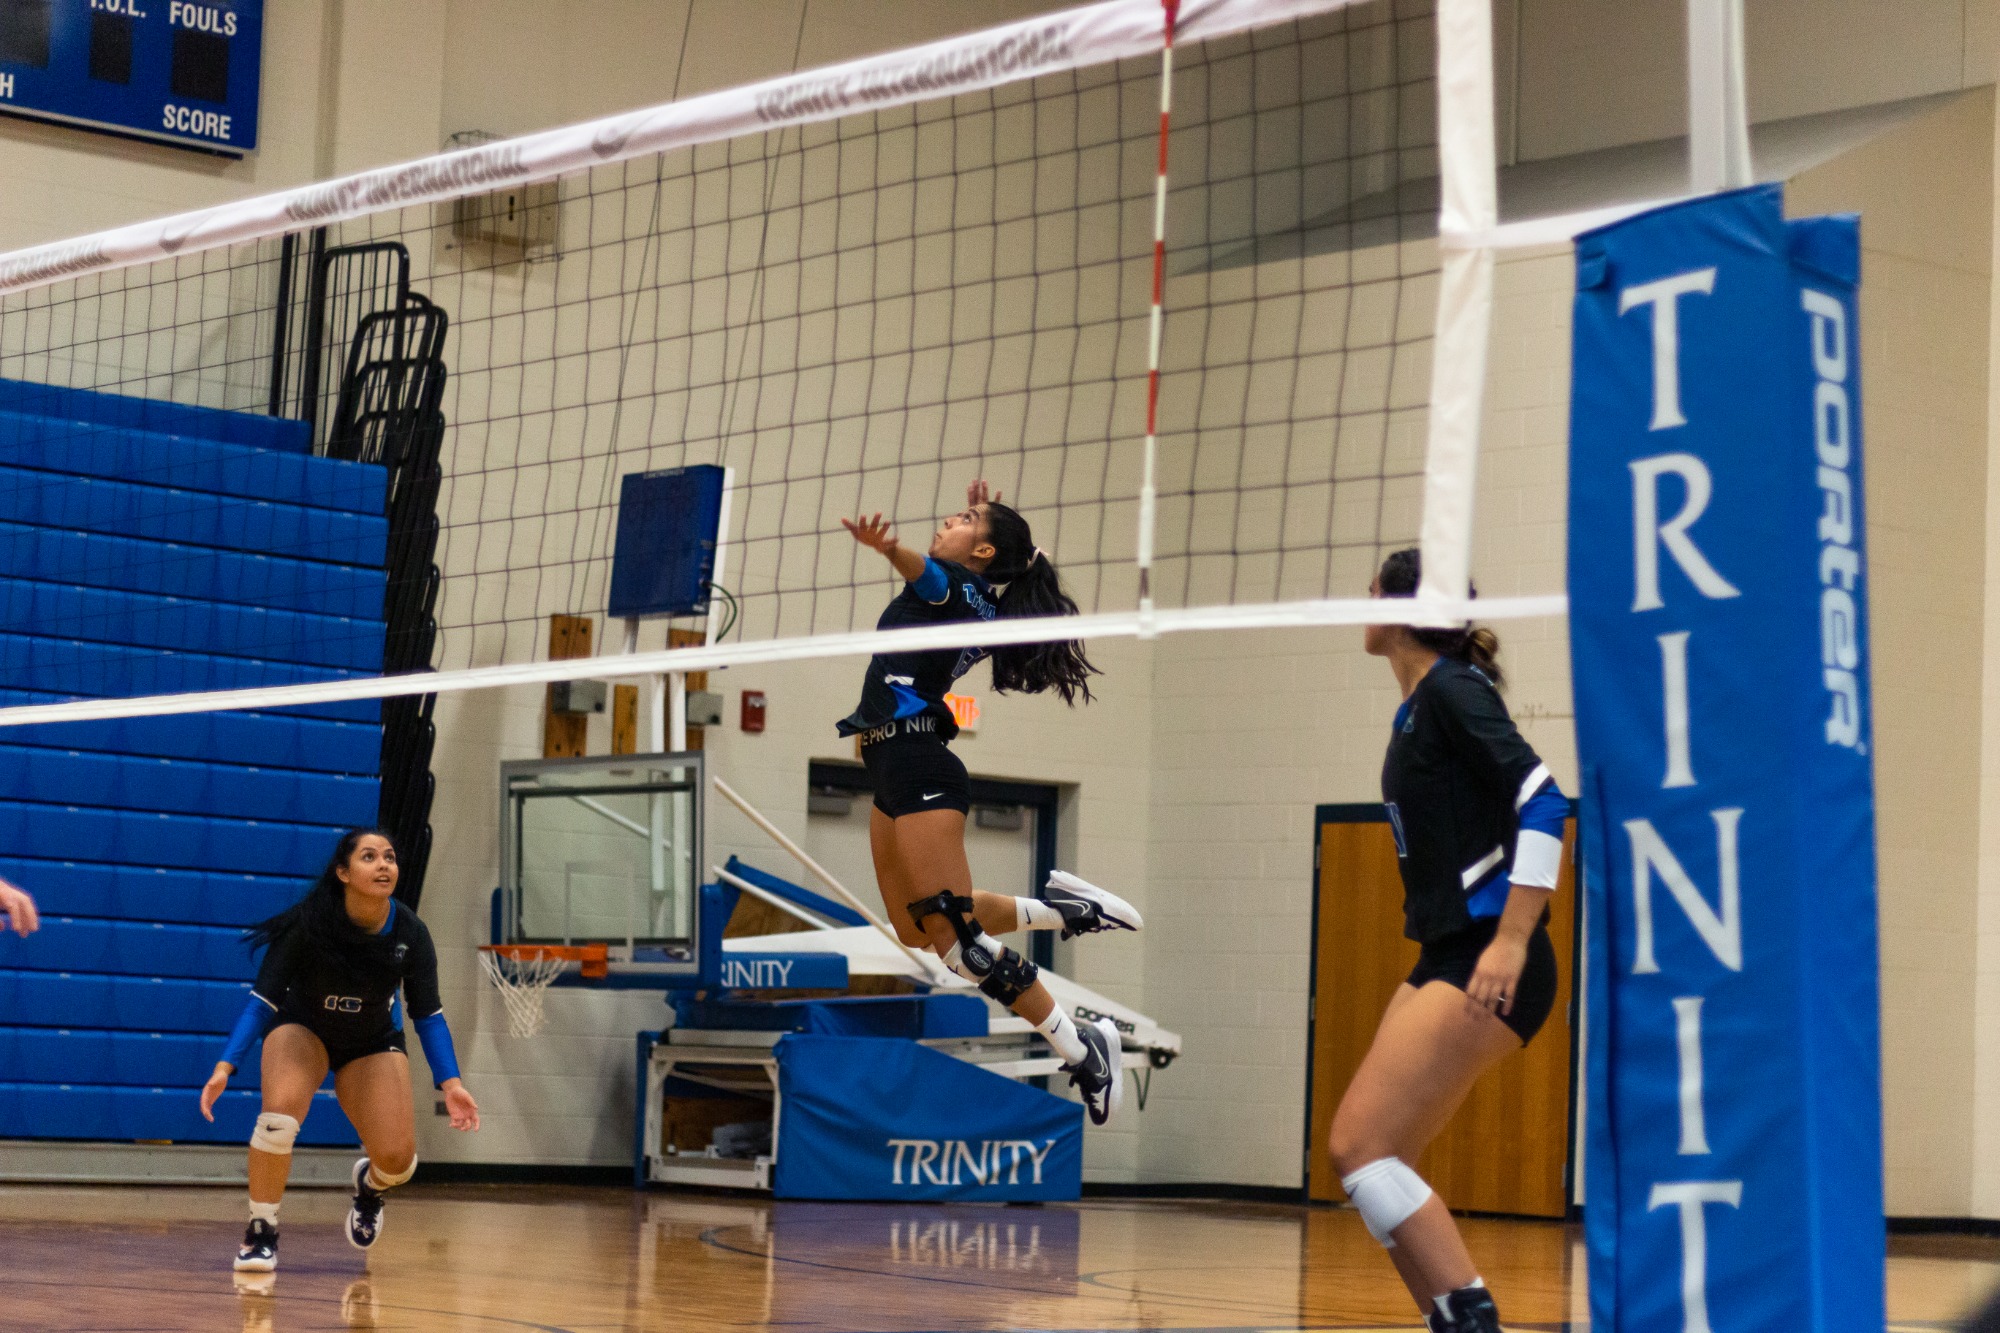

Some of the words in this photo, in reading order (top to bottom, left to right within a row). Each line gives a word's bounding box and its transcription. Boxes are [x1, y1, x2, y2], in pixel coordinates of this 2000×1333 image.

[169, 1, 237, 36] FOULS
[162, 104, 231, 139] SCORE
[906, 716, 937, 734] NIK
[887, 1139, 1056, 1186] TRINITY
